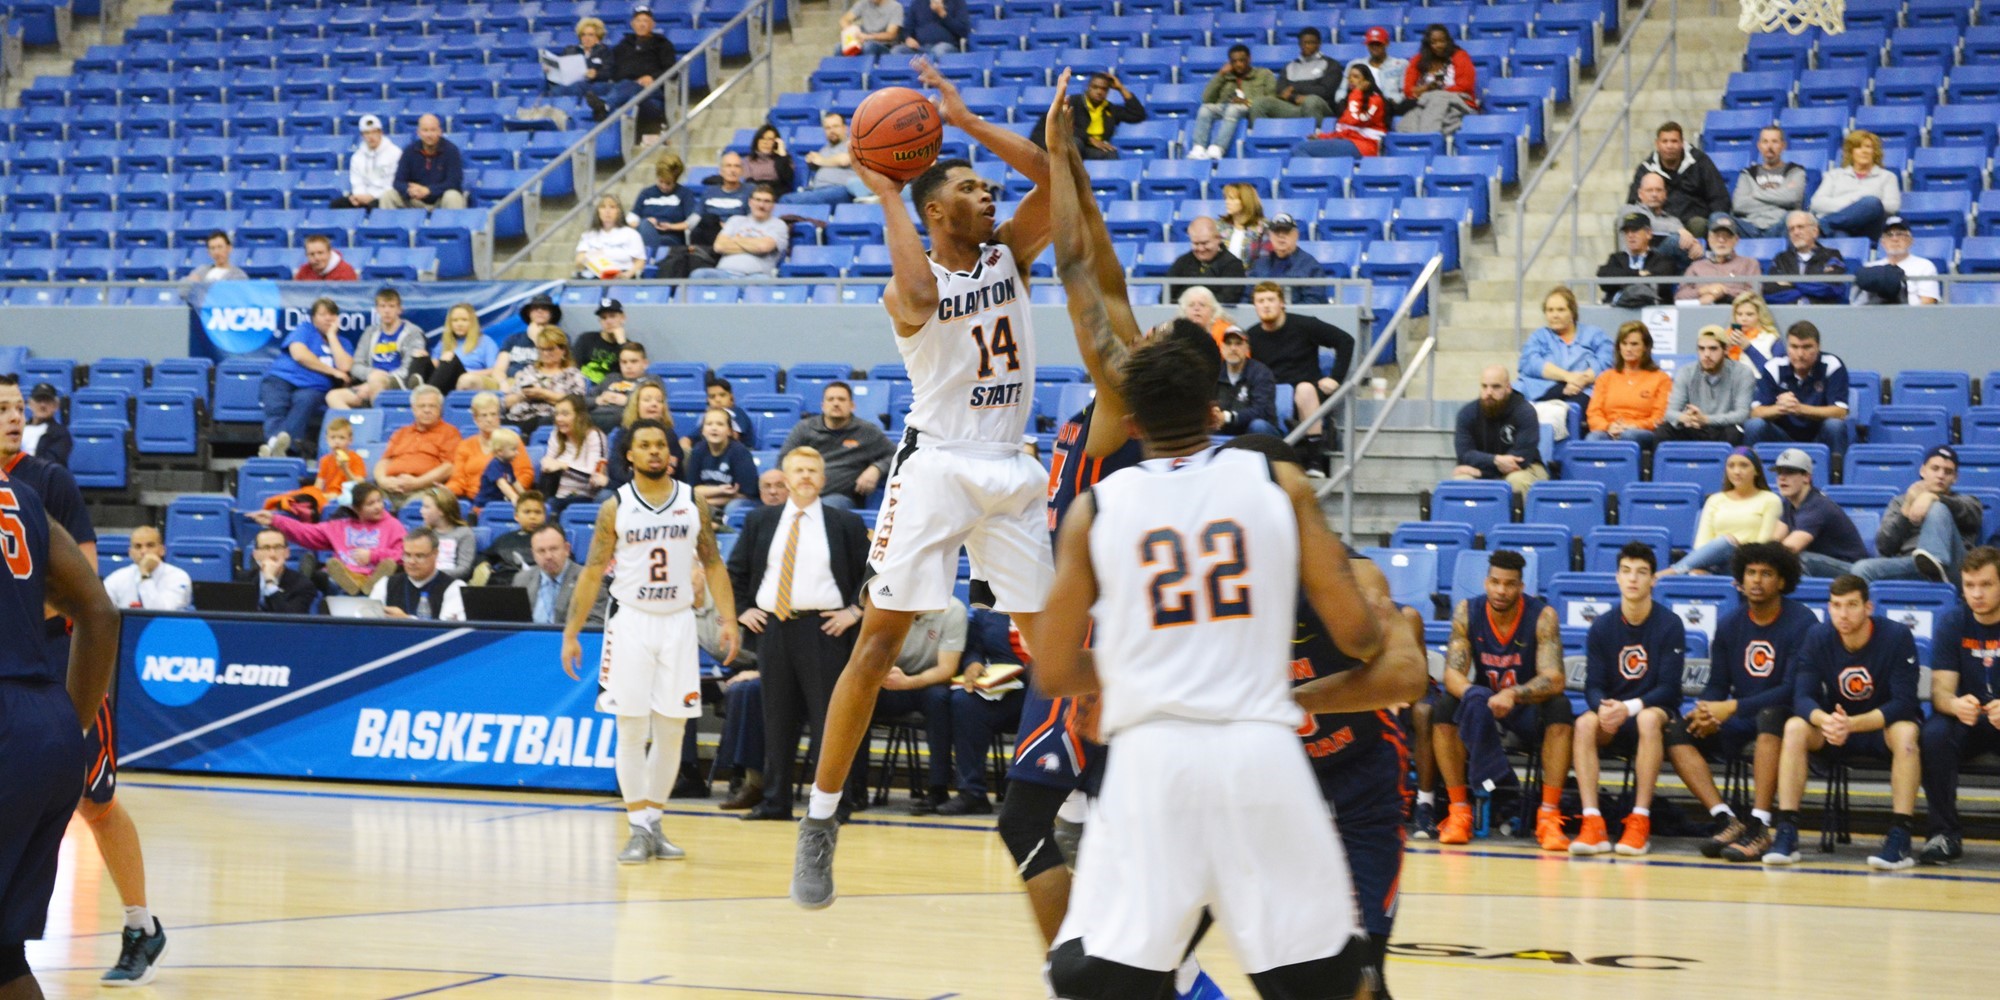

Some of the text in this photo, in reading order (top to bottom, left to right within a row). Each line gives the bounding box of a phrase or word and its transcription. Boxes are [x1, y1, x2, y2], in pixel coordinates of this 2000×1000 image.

[938, 277, 1016, 324] CLAYTON
[207, 307, 277, 332] NCAA
[971, 316, 1021, 380] 14
[970, 382, 1023, 409] STATE
[626, 525, 690, 544] CLAYTON
[871, 482, 901, 562] LAKERS
[649, 547, 668, 583] 2
[1138, 518, 1255, 630] 22
[637, 586, 678, 601] STATE
[141, 655, 291, 687] NCAA.com
[351, 707, 616, 768] BASKETBALL
